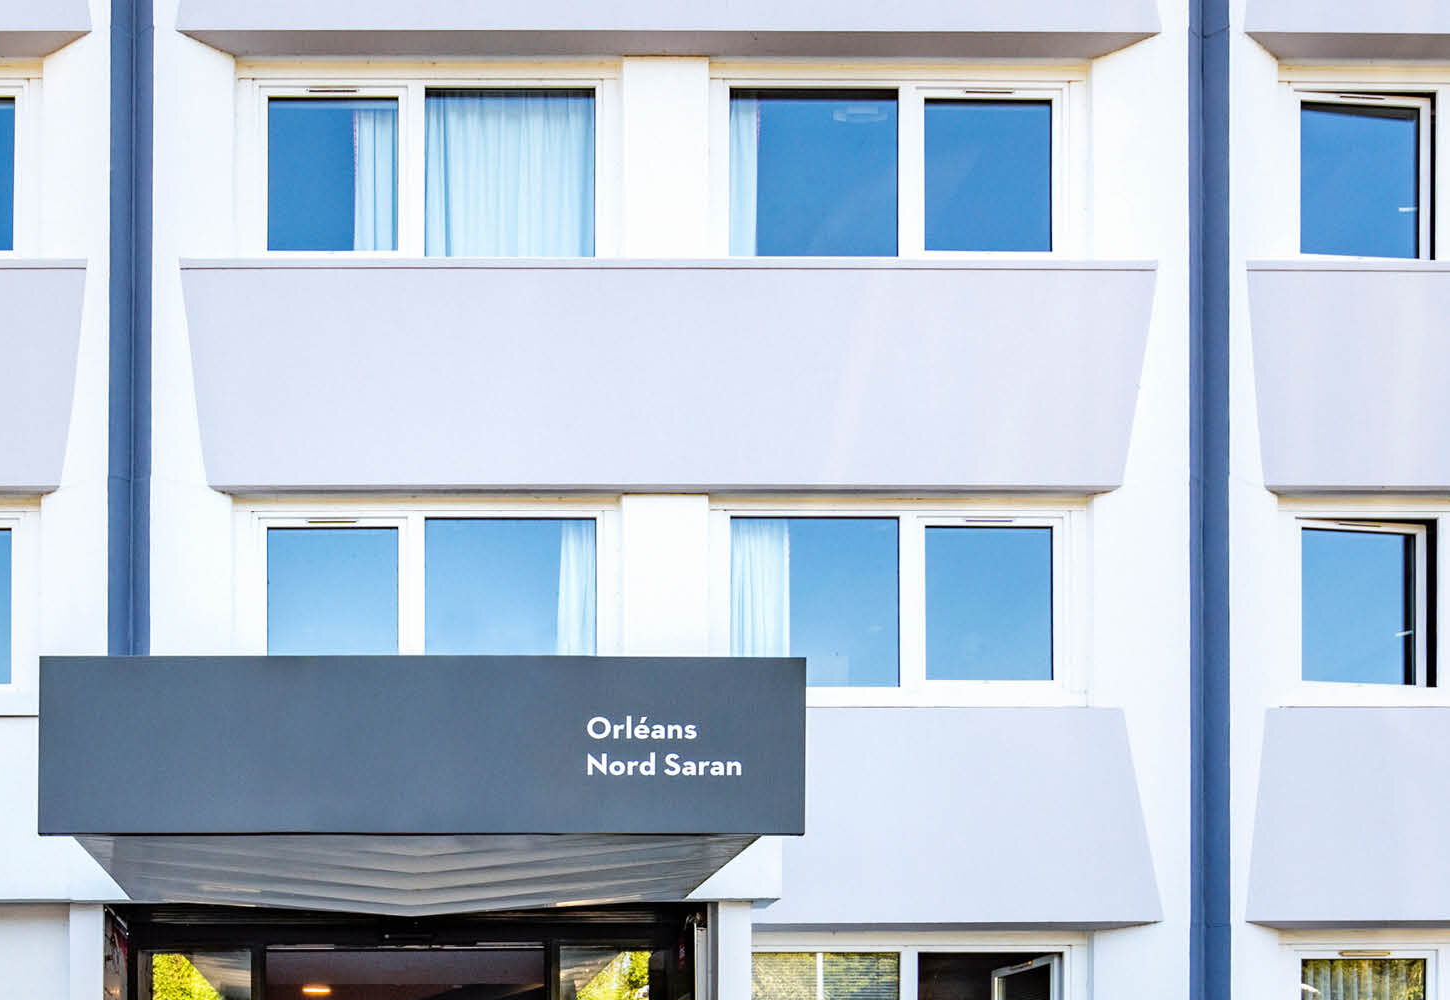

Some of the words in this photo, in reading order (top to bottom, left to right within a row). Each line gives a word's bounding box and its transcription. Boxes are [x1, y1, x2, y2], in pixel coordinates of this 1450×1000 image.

[586, 715, 698, 740] Orléans
[586, 752, 657, 777] Nord
[663, 753, 743, 777] Saran
